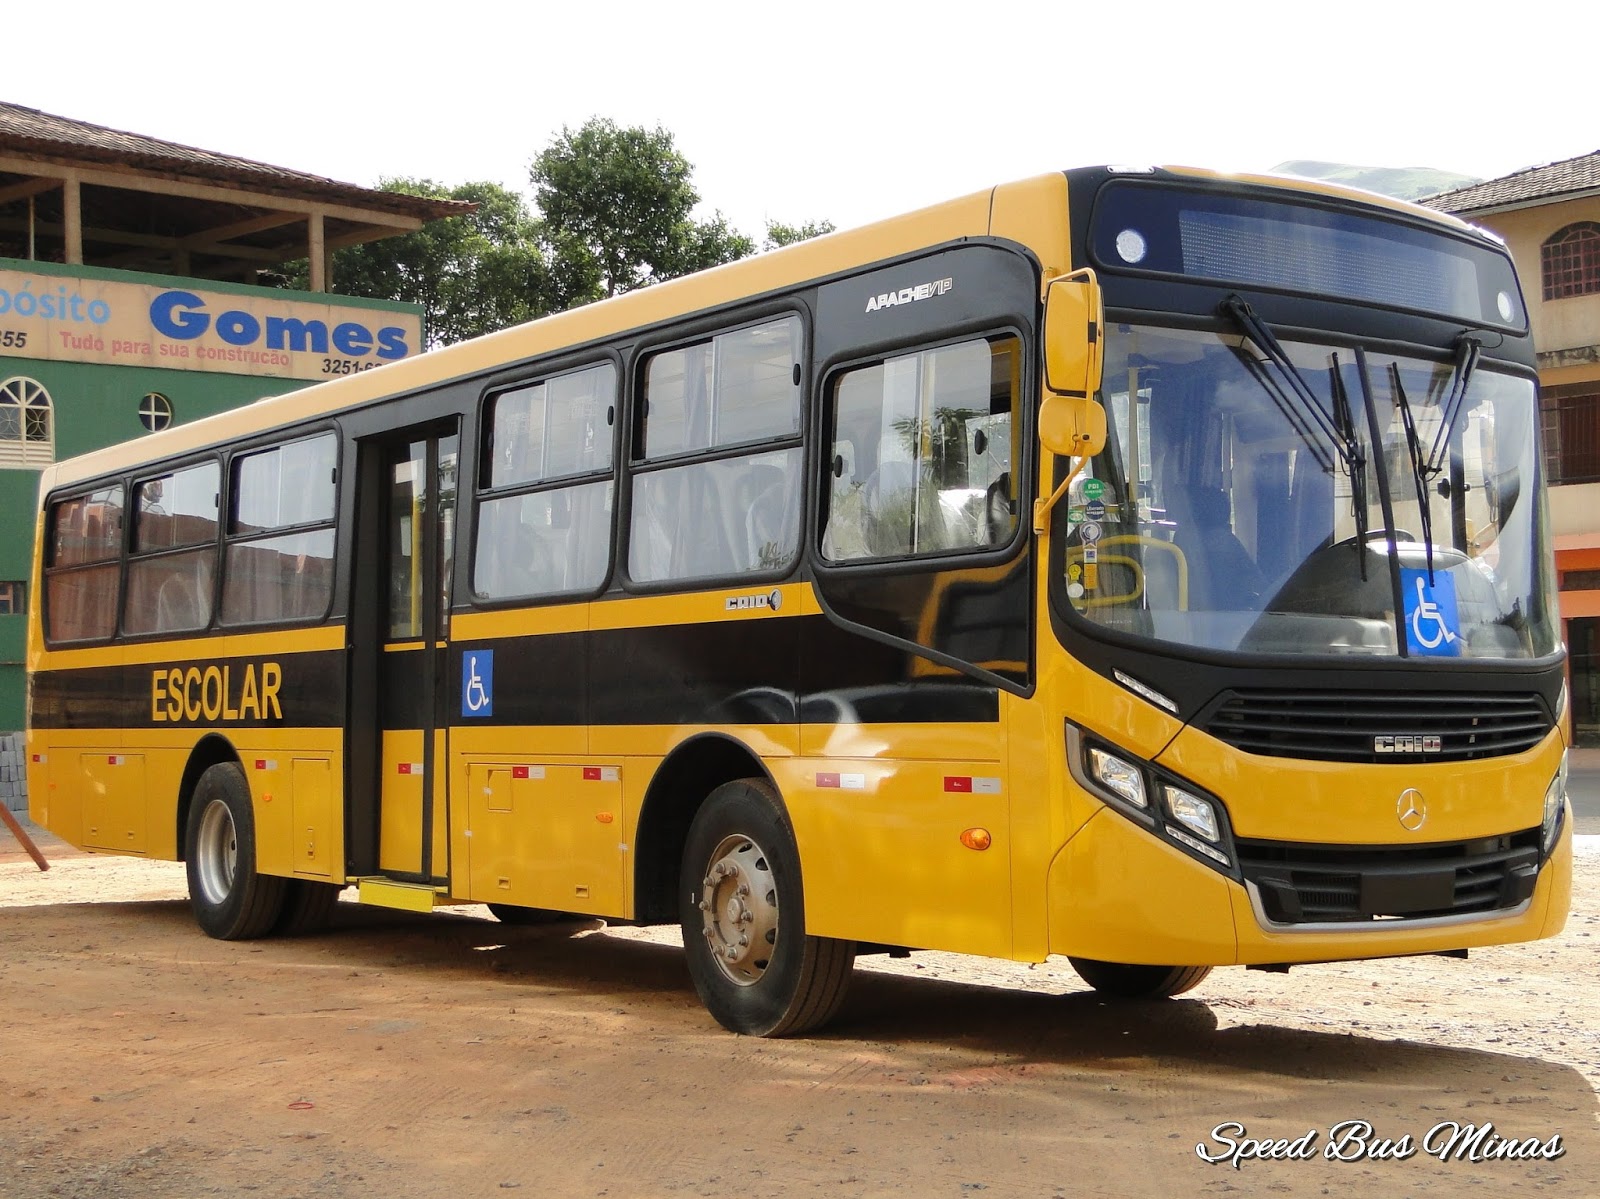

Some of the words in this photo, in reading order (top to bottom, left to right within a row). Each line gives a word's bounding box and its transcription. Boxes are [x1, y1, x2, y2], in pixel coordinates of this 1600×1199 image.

[149, 290, 409, 360] Gomes
[0, 330, 27, 348] 55
[59, 331, 105, 351] Tudo
[111, 337, 151, 357] para
[159, 343, 189, 358] sua
[725, 595, 768, 610] CAIO
[152, 662, 283, 722] ESCOLAR
[1374, 736, 1441, 753] CAIO
